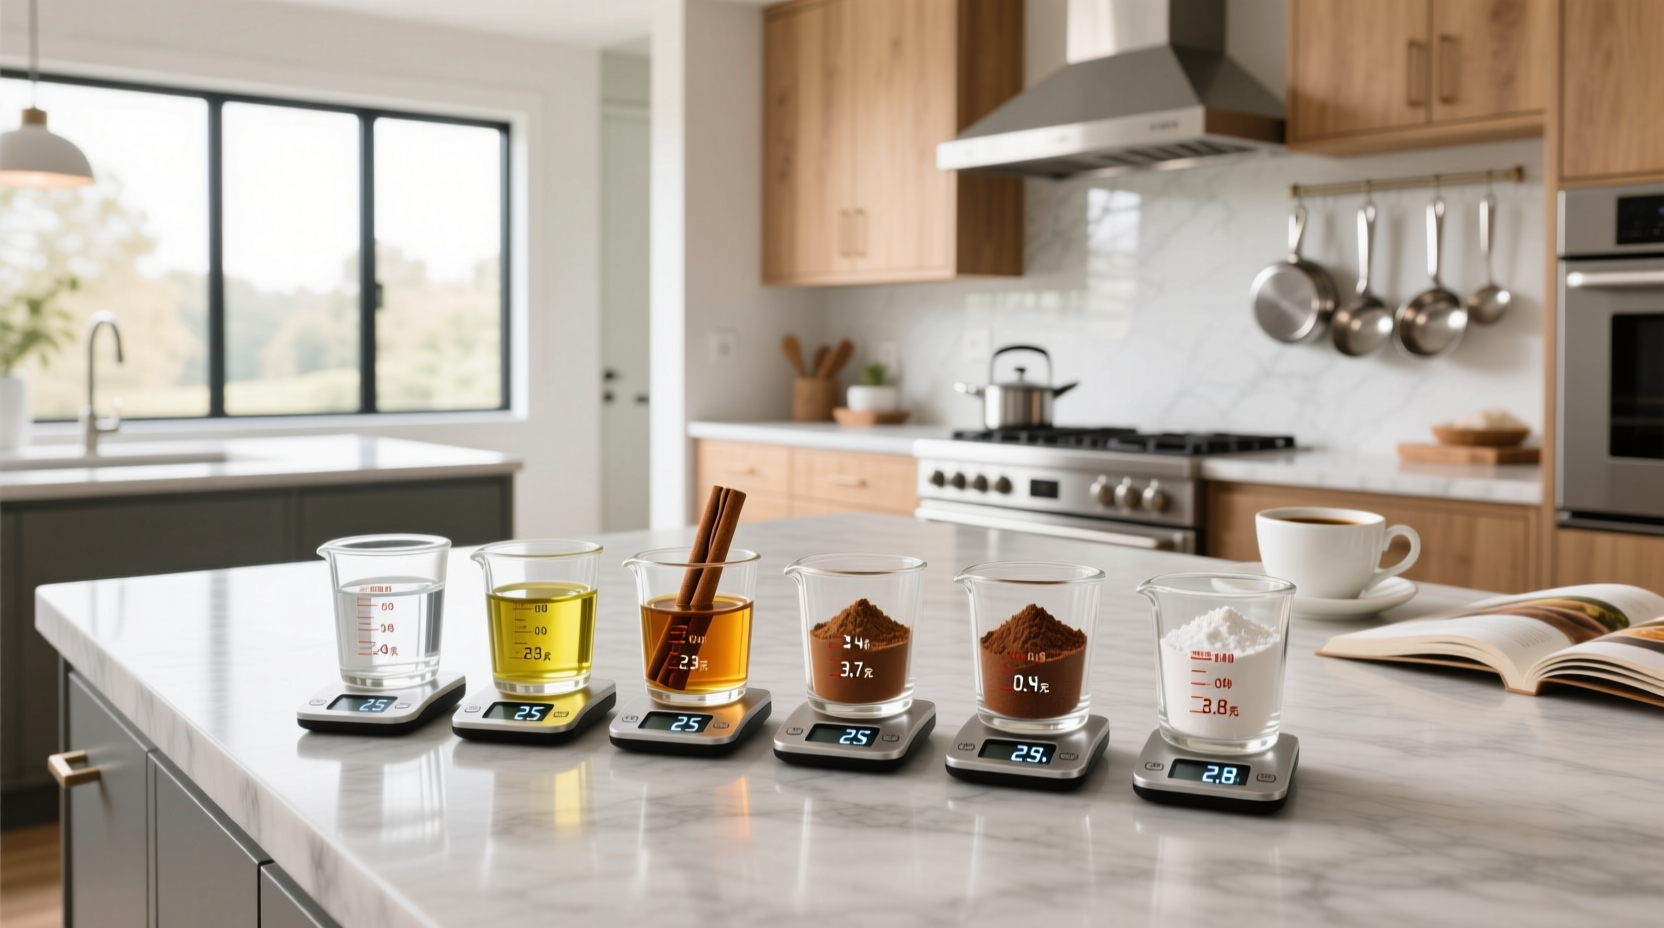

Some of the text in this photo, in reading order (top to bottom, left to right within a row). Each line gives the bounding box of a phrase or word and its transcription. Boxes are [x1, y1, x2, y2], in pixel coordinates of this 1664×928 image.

[359, 698, 388, 711] 25
[514, 705, 545, 721] 25
[671, 716, 702, 732] 25
[839, 728, 871, 745] 25
[1202, 765, 1237, 784] 2.8
